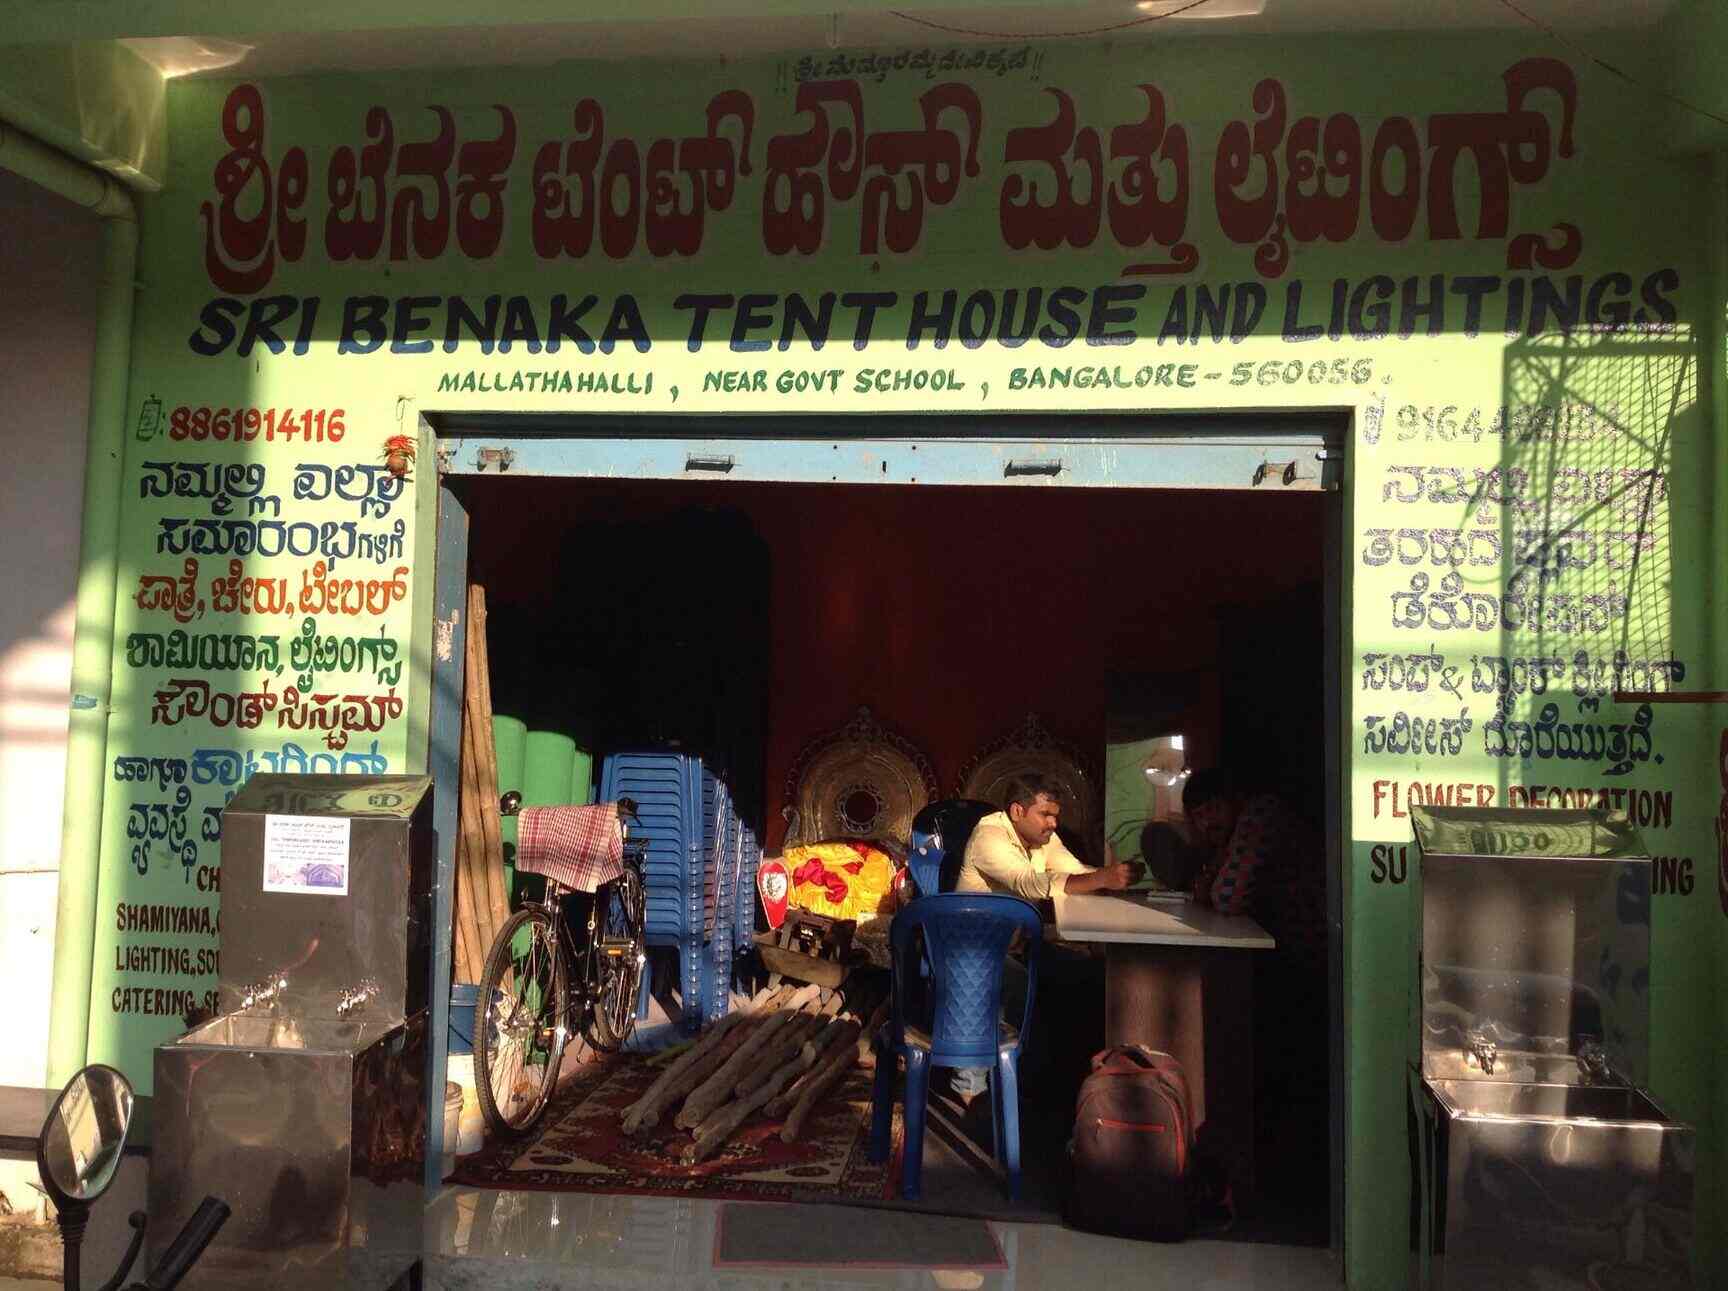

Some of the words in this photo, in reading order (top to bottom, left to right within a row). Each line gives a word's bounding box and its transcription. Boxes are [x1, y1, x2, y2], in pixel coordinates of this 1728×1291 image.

[200, 82, 309, 295] ಶ್ರೀ
[325, 105, 517, 261] ಬೆನಕ
[532, 89, 754, 260] ಟೆಂಟ್
[763, 79, 982, 256] ಹೌಸ್
[1000, 84, 1199, 277] ಮತ್ತು
[1213, 57, 1582, 279] ಲೈಟಿಂಗ್ಸ್
[188, 295, 321, 357] SRI
[337, 294, 651, 355] BENAKA
[673, 291, 897, 352] TENT
[906, 284, 1147, 350] HOUSE
[1157, 281, 1266, 347] AND
[1282, 268, 1680, 342] LIGHTINGS
[702, 370, 768, 393] NEAR
[776, 369, 844, 393] GOVT
[169, 406, 346, 442] 8861914116
[140, 461, 281, 517] ನಮ್ಮಲ್ಲಿ
[299, 560, 409, 616] ಟೇಬಲ್
[1372, 780, 1496, 818] FLOWER
